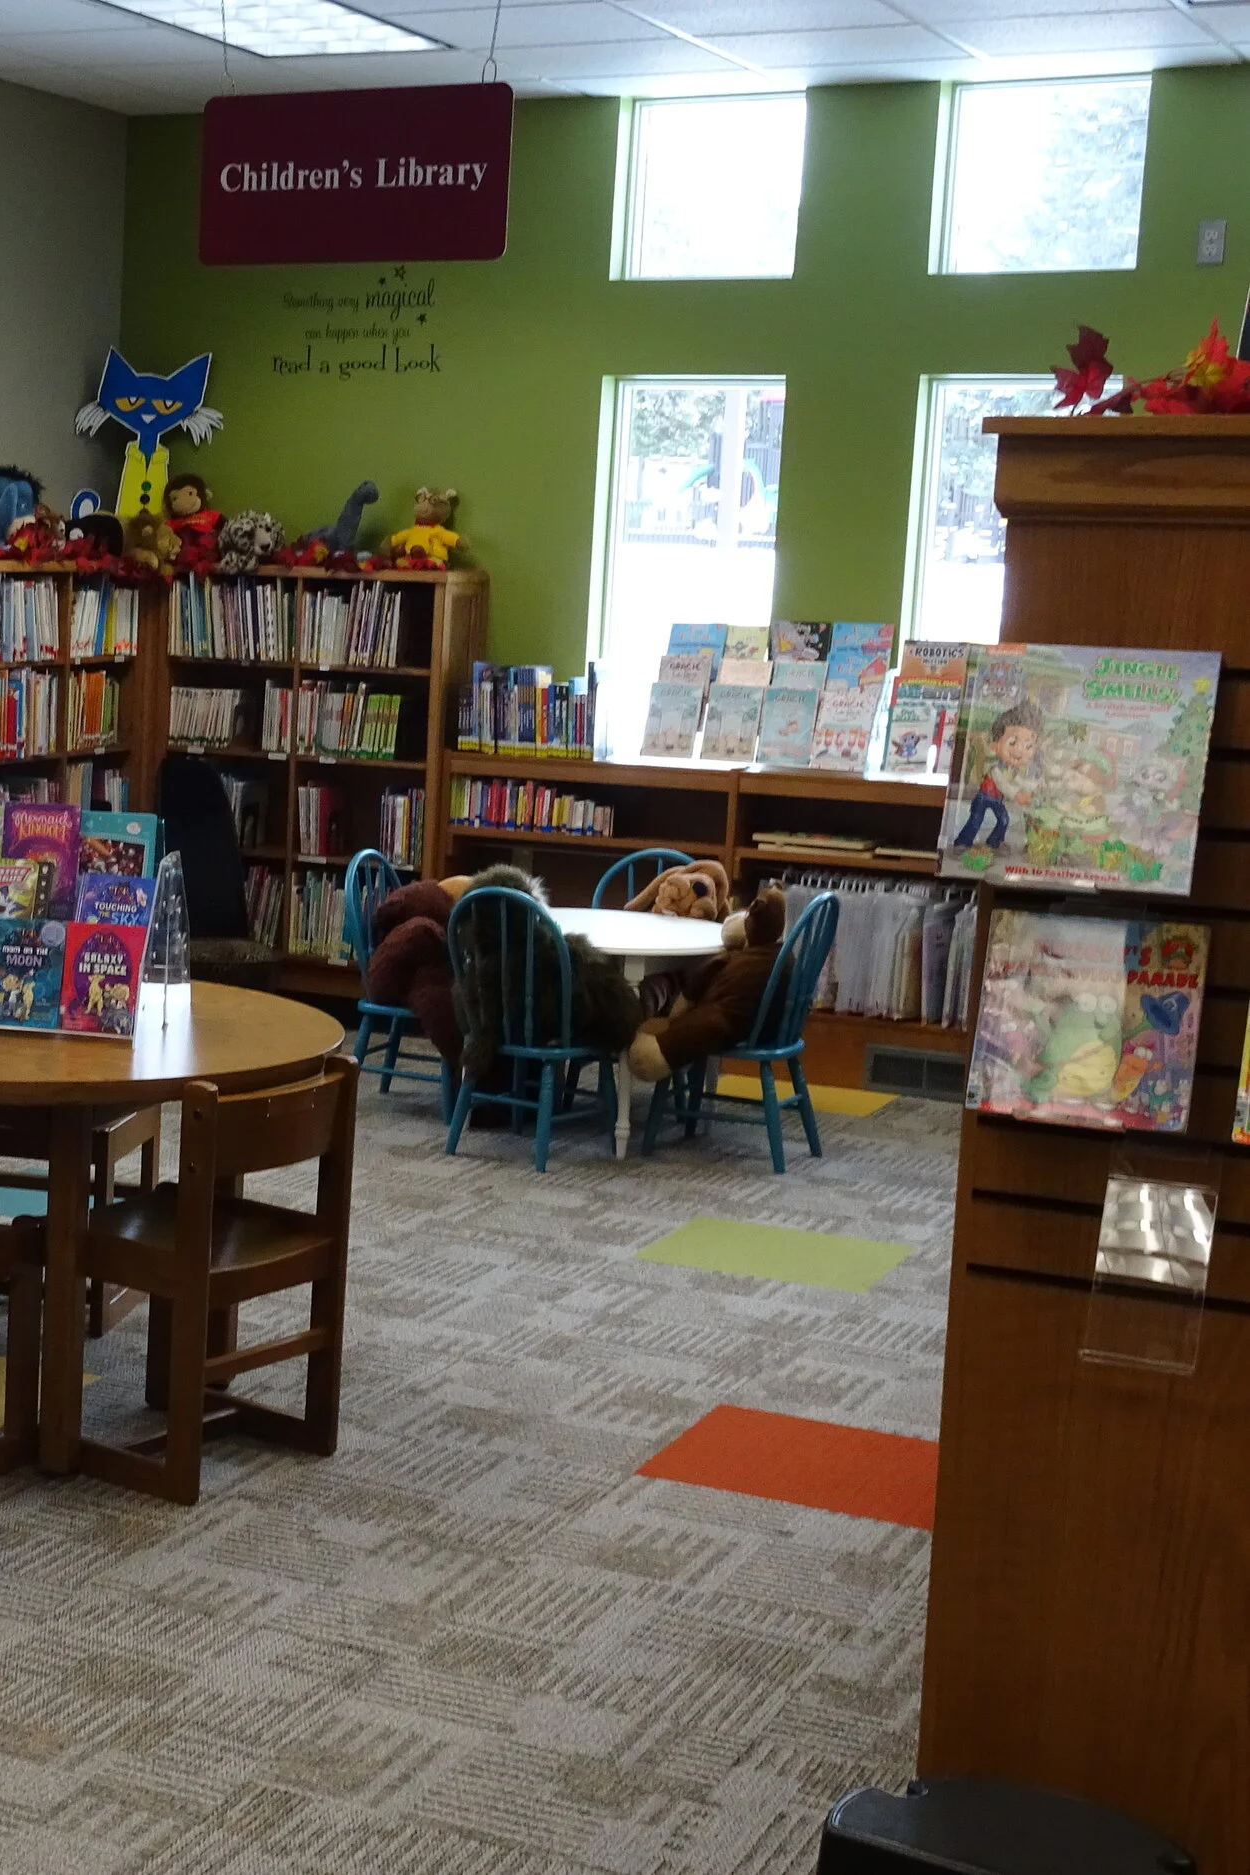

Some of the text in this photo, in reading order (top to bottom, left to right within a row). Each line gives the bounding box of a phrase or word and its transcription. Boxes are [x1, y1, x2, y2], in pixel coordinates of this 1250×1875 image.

[220, 157, 488, 193] Children's Library
[366, 278, 436, 321] magical
[325, 322, 359, 344] happen
[363, 322, 389, 338] when
[273, 344, 442, 381] read a good book
[914, 647, 964, 658] ROBOTICS
[1093, 656, 1181, 681] JINGLE
[11, 810, 73, 828] Mermaid
[94, 901, 137, 913] TOUCHING
[111, 912, 139, 926] SKY
[6, 954, 43, 967] MOON
[1127, 970, 1199, 989] PARADE
